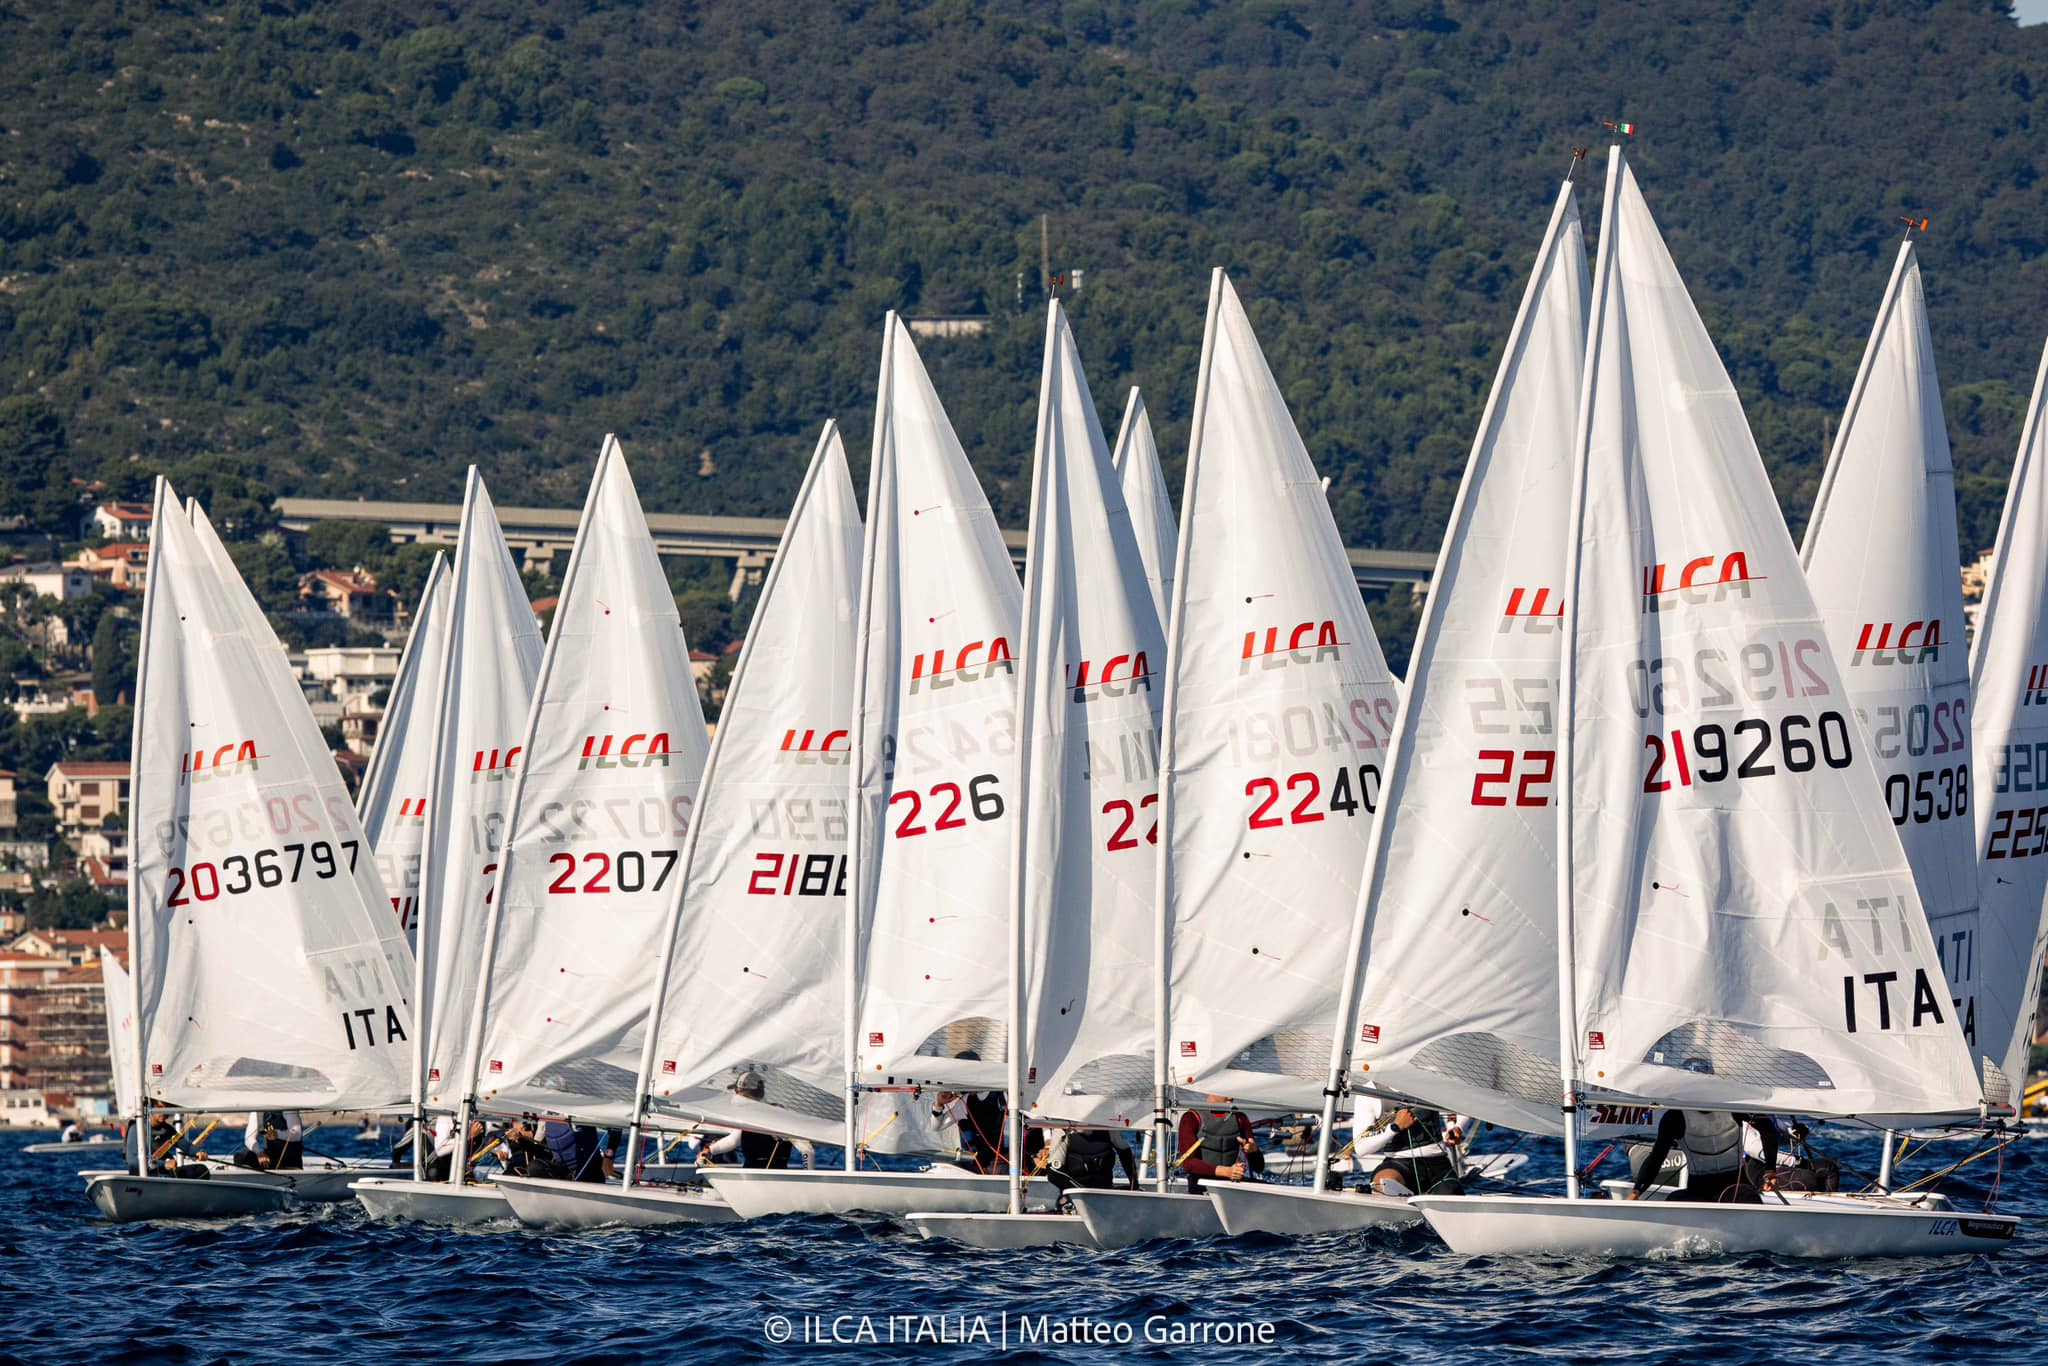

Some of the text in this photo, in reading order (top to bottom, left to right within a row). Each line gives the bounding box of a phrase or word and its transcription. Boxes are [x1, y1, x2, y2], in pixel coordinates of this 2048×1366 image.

[1642, 551, 1752, 614] ILCA
[1498, 587, 1564, 634] IL
[909, 637, 1013, 695] ILCA
[1239, 620, 1341, 676] ILCA
[1850, 619, 1940, 667] ILCA
[181, 740, 259, 786] ILCA
[578, 733, 670, 770] ILCA
[775, 729, 852, 765] ILC
[1643, 711, 1852, 793] 219260
[1844, 968, 1944, 1033] ITA
[342, 1004, 407, 1051] ITA
[1928, 1220, 1957, 1236] ILCA
